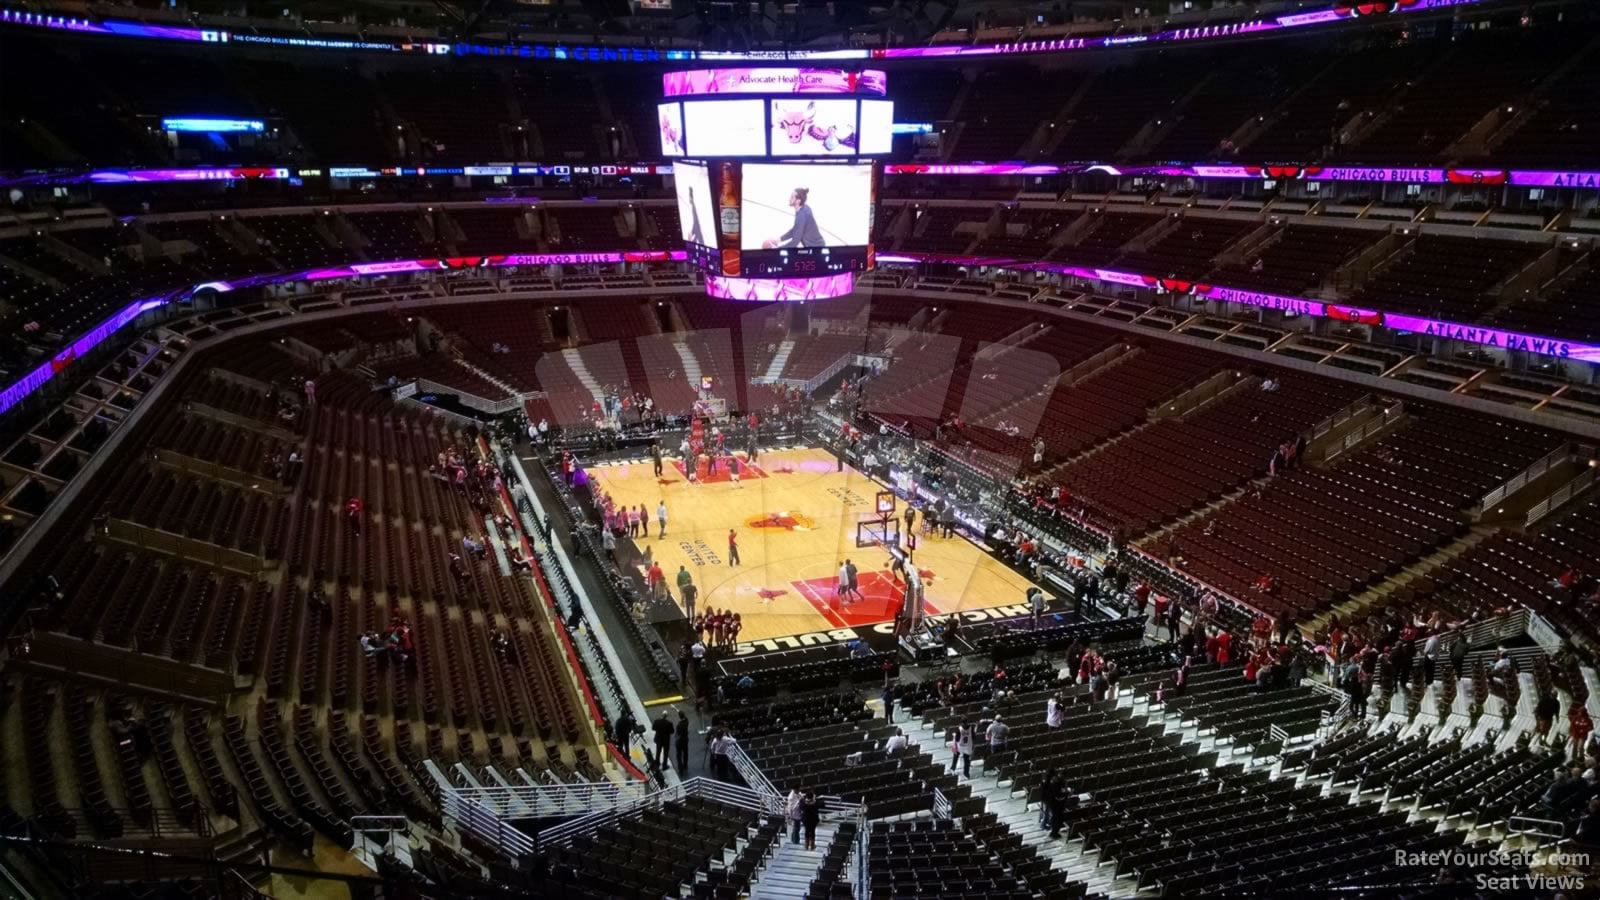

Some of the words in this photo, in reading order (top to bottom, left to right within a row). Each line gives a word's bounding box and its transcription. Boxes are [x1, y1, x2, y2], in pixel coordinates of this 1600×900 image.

[573, 47, 660, 60] CENTER
[739, 75, 776, 83] Advocate
[778, 74, 804, 84] Health
[805, 75, 823, 83] Care
[1331, 168, 1386, 181] CHICAGO
[1391, 169, 1430, 182] BULLS
[1554, 174, 1600, 187] ATLA
[517, 255, 571, 265] CHICAGO
[576, 254, 609, 264] BULLS
[1220, 289, 1270, 307] CHICAGO
[1276, 298, 1310, 315] BULLS
[1425, 322, 1498, 346] ATLANTA
[1506, 334, 1570, 358] HAWKS
[679, 541, 706, 567] CENTER
[694, 539, 721, 565] UNITED
[735, 627, 859, 656] BULLS
